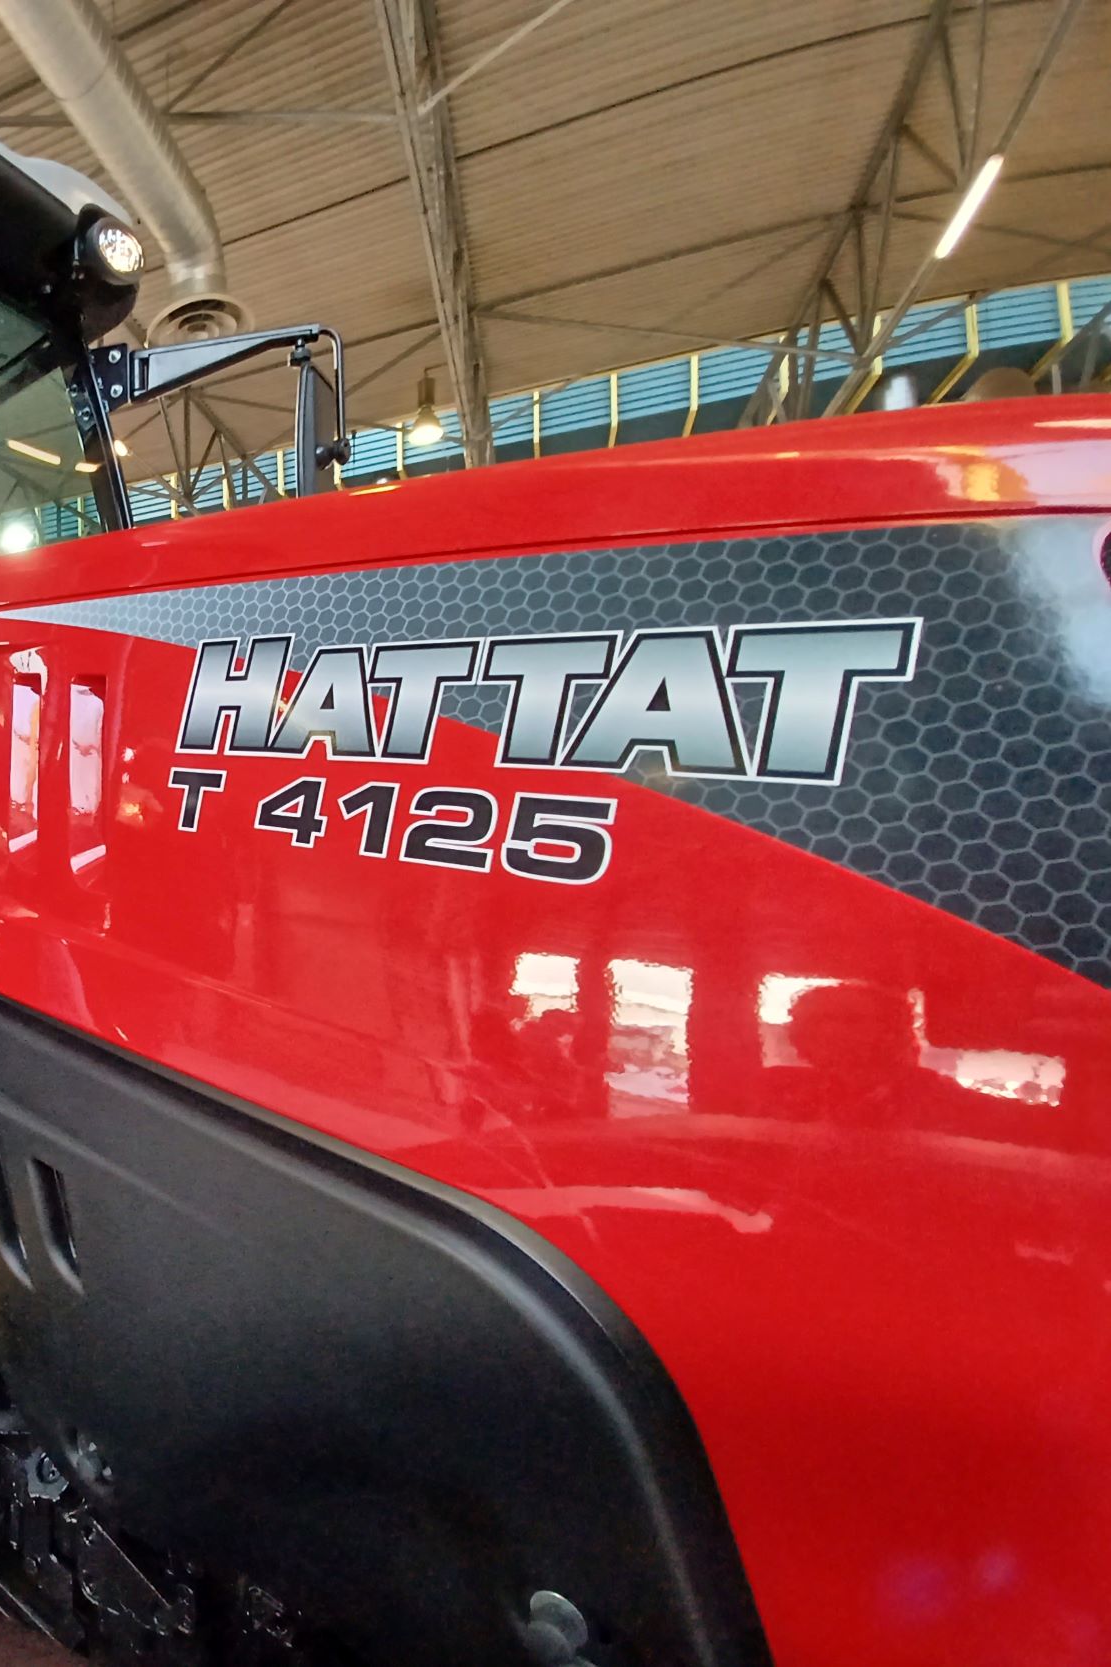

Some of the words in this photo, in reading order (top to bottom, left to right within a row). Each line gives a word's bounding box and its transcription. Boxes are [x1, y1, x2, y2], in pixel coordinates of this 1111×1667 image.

[175, 617, 924, 785] HATTAT
[168, 769, 227, 832] T
[256, 776, 618, 885] 4125
